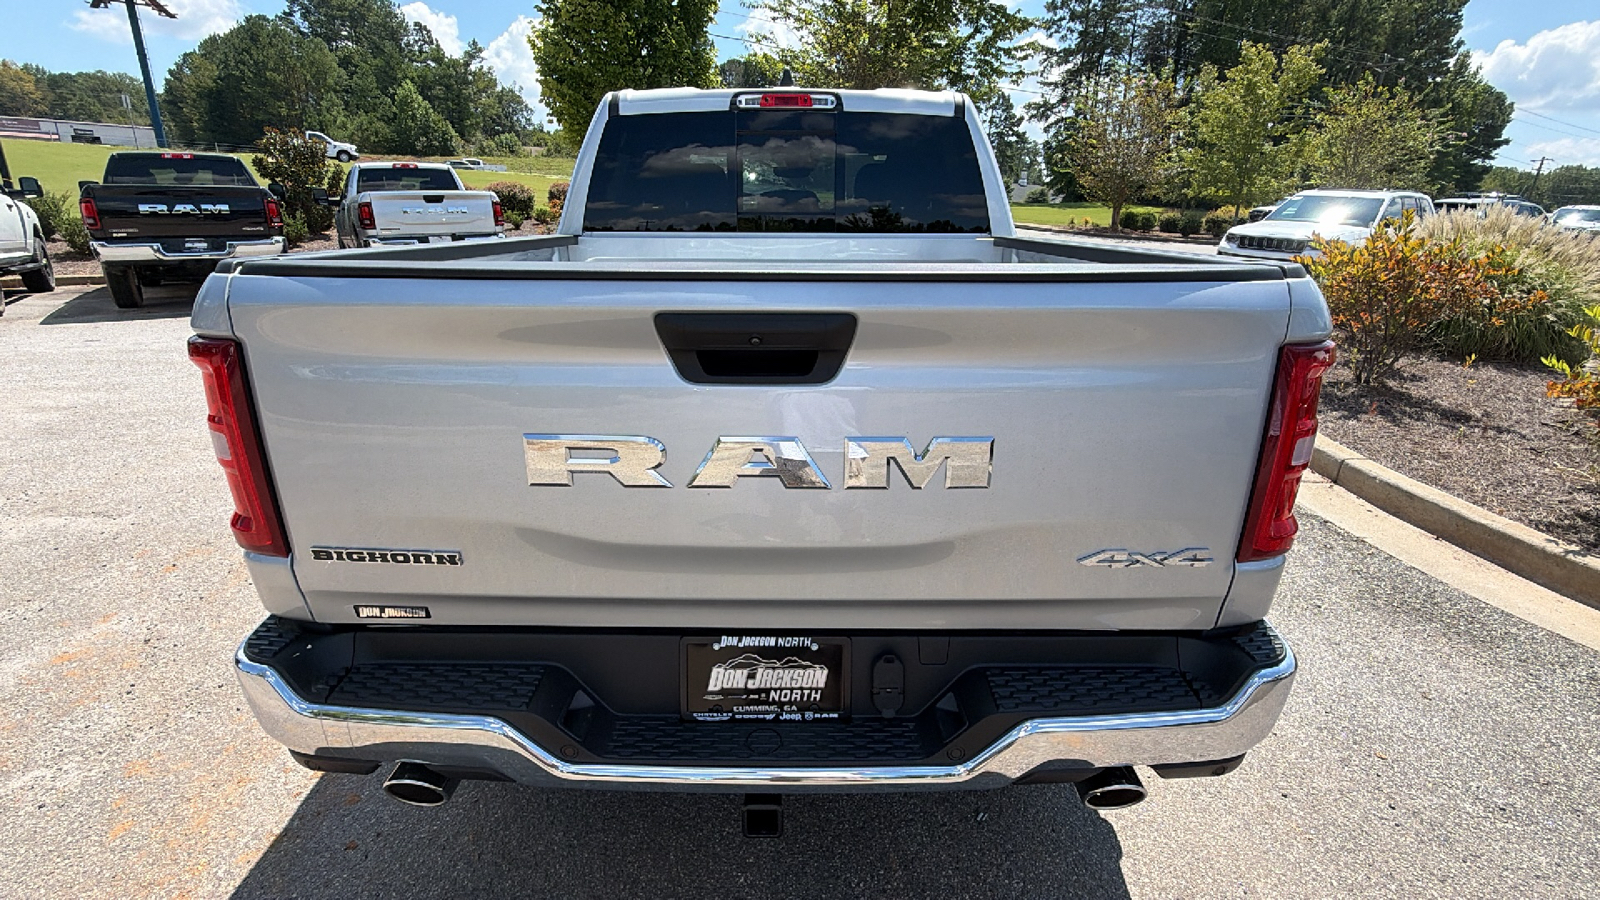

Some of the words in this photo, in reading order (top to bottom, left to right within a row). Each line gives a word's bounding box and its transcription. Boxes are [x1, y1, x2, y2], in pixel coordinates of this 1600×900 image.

[138, 203, 230, 214] RAM
[522, 432, 995, 489] RAM
[310, 545, 463, 566] BIGHORN
[358, 606, 380, 618] DON
[720, 635, 739, 648] DON
[738, 635, 776, 648] JACKSON
[777, 637, 812, 647] NORTH
[707, 667, 748, 691] DON
[747, 667, 828, 689] JACKSON
[769, 690, 821, 702] NORTH
[779, 711, 803, 721] Jeep
